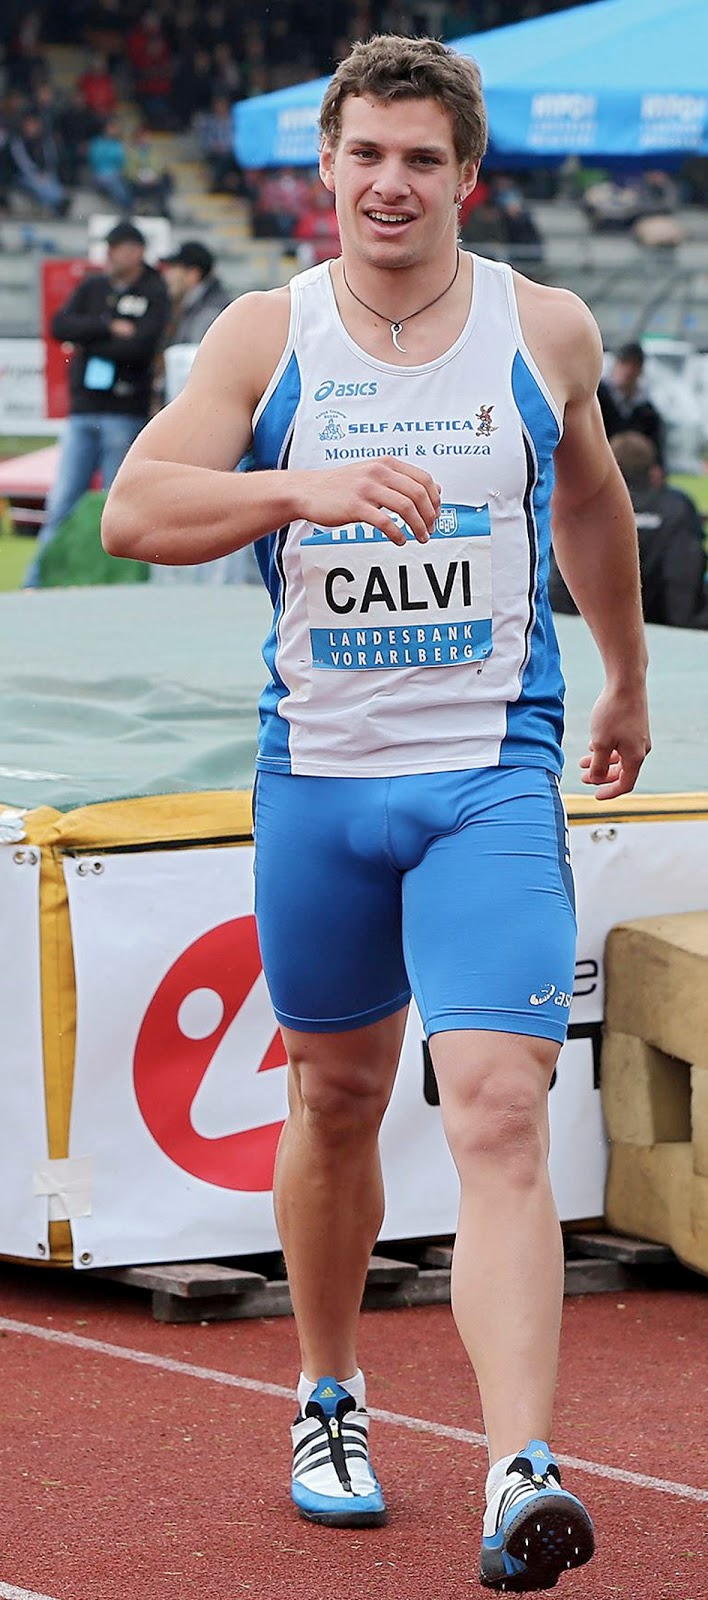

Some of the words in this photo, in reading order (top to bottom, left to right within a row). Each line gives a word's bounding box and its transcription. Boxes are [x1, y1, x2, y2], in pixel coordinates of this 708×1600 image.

[335, 383, 377, 397] asics
[348, 423, 389, 434] SELF
[393, 420, 474, 433] ATLETICA
[325, 444, 409, 460] Montanari
[415, 444, 427, 456] &
[433, 443, 491, 456] Gruzza
[325, 560, 472, 614] CALVI
[329, 625, 473, 647] LANDESBANK
[331, 645, 473, 666] VORARLBERG
